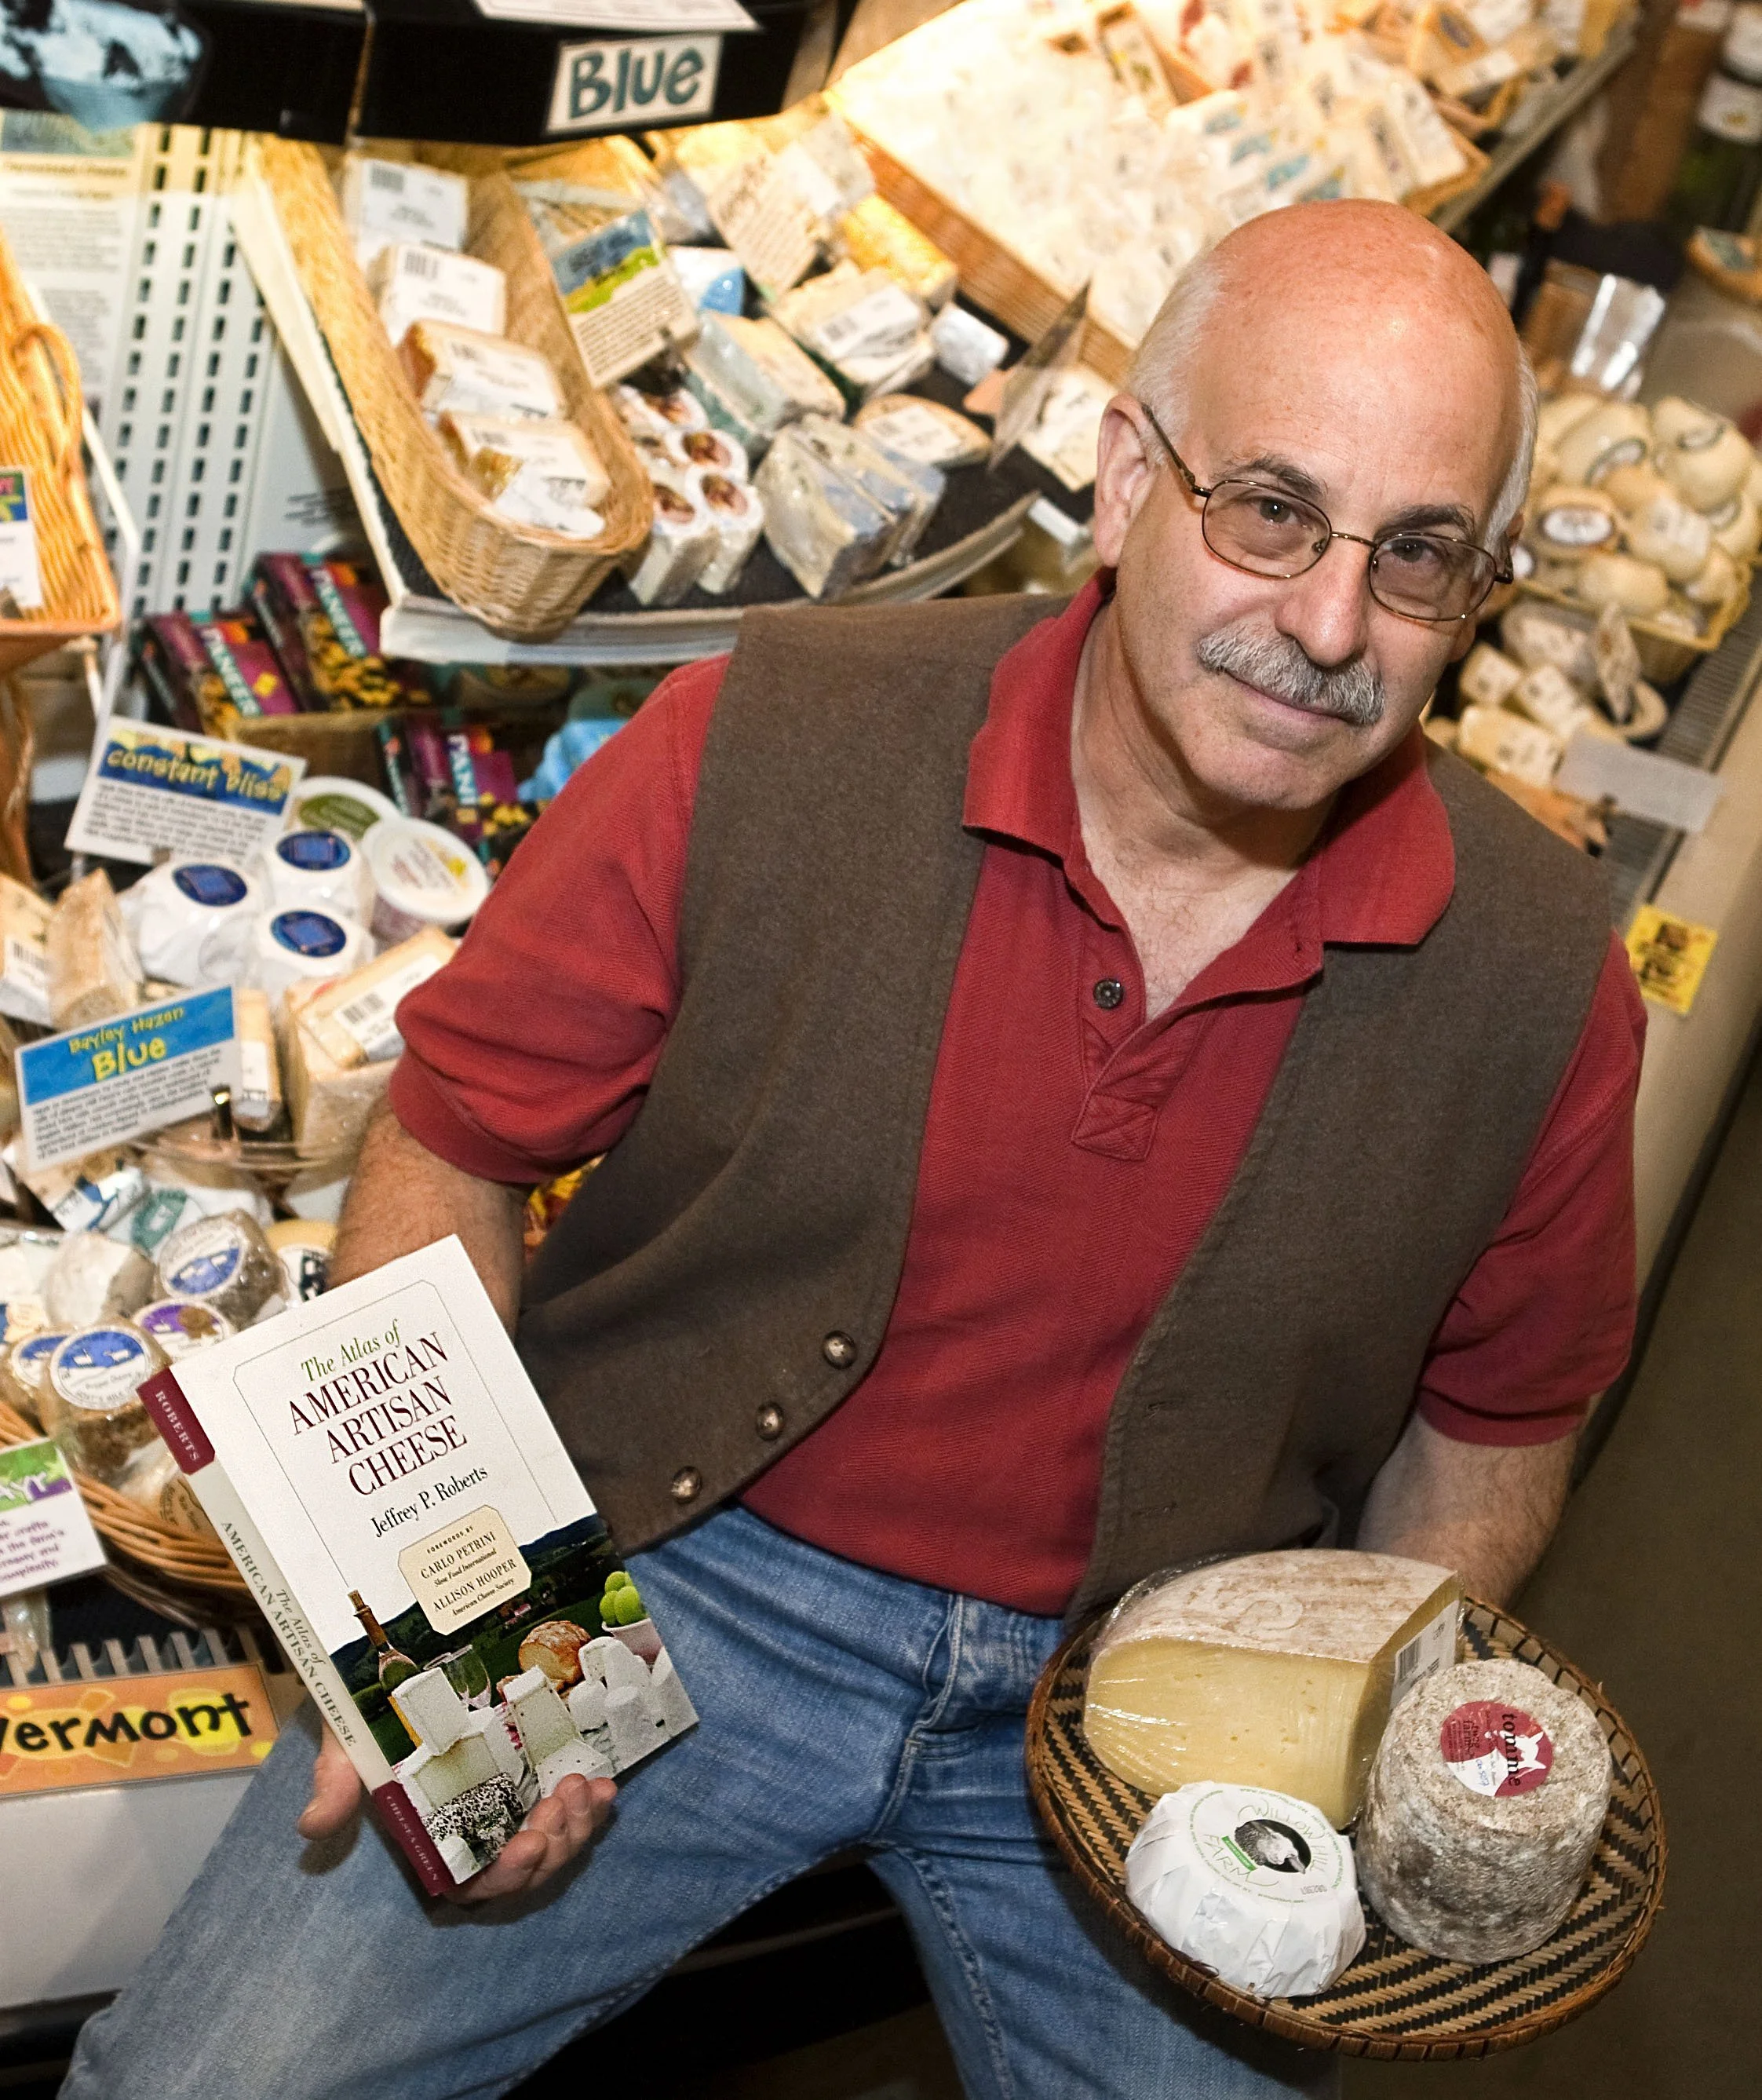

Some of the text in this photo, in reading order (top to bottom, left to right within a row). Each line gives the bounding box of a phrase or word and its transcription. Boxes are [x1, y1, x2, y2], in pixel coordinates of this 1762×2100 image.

[568, 46, 703, 119] Blue
[106, 749, 221, 791] constant
[92, 1037, 167, 1082] Blue
[289, 1331, 448, 1436] AMERICAN
[301, 1319, 402, 1382] The Atlas of
[155, 1390, 201, 1462] ROBERTS
[326, 1375, 453, 1464] ARTISAN
[348, 1415, 468, 1496] CHEESE
[370, 1466, 488, 1539] Jeffrey P. Roberts
[421, 1531, 497, 1579] CARLO PETRINI
[426, 1531, 465, 1554] FOREWORDS
[447, 1567, 463, 1582] Food
[461, 1547, 498, 1574] International
[432, 1558, 517, 1612] ALLISON HOOPER
[452, 1598, 478, 1616] American
[221, 1521, 356, 1748] AMERICAN ARTISAN CHEESE
[275, 1588, 326, 1667] The Atlas of
[1501, 1712, 1521, 1787] tomme
[385, 1795, 439, 1882] CHELSEA GREEN
[1238, 1798, 1326, 1840] WILLOW
[1308, 1844, 1330, 1873] HILL
